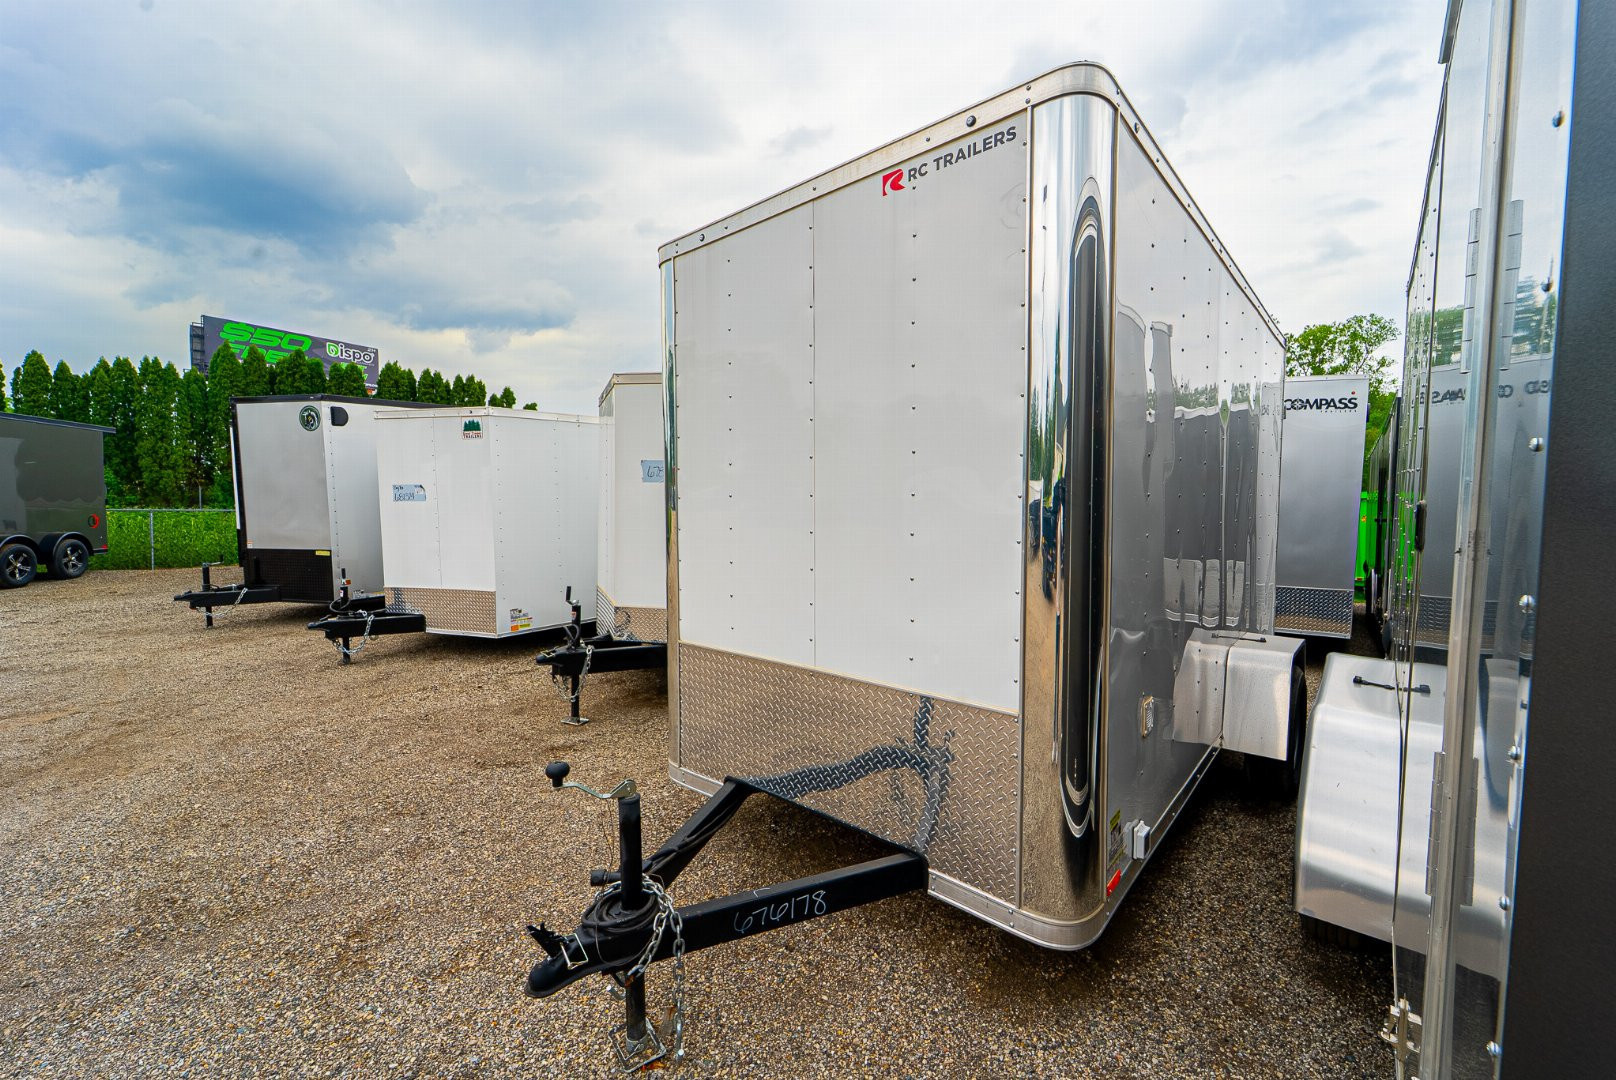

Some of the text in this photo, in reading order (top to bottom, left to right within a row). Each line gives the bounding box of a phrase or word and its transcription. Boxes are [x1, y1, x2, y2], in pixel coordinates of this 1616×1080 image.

[907, 163, 928, 182] RC
[933, 126, 1017, 170] TRAILERS
[219, 322, 312, 351] $50
[326, 342, 375, 364] Dispo
[1284, 397, 1358, 411] COMPASS
[733, 889, 827, 934] 676178
